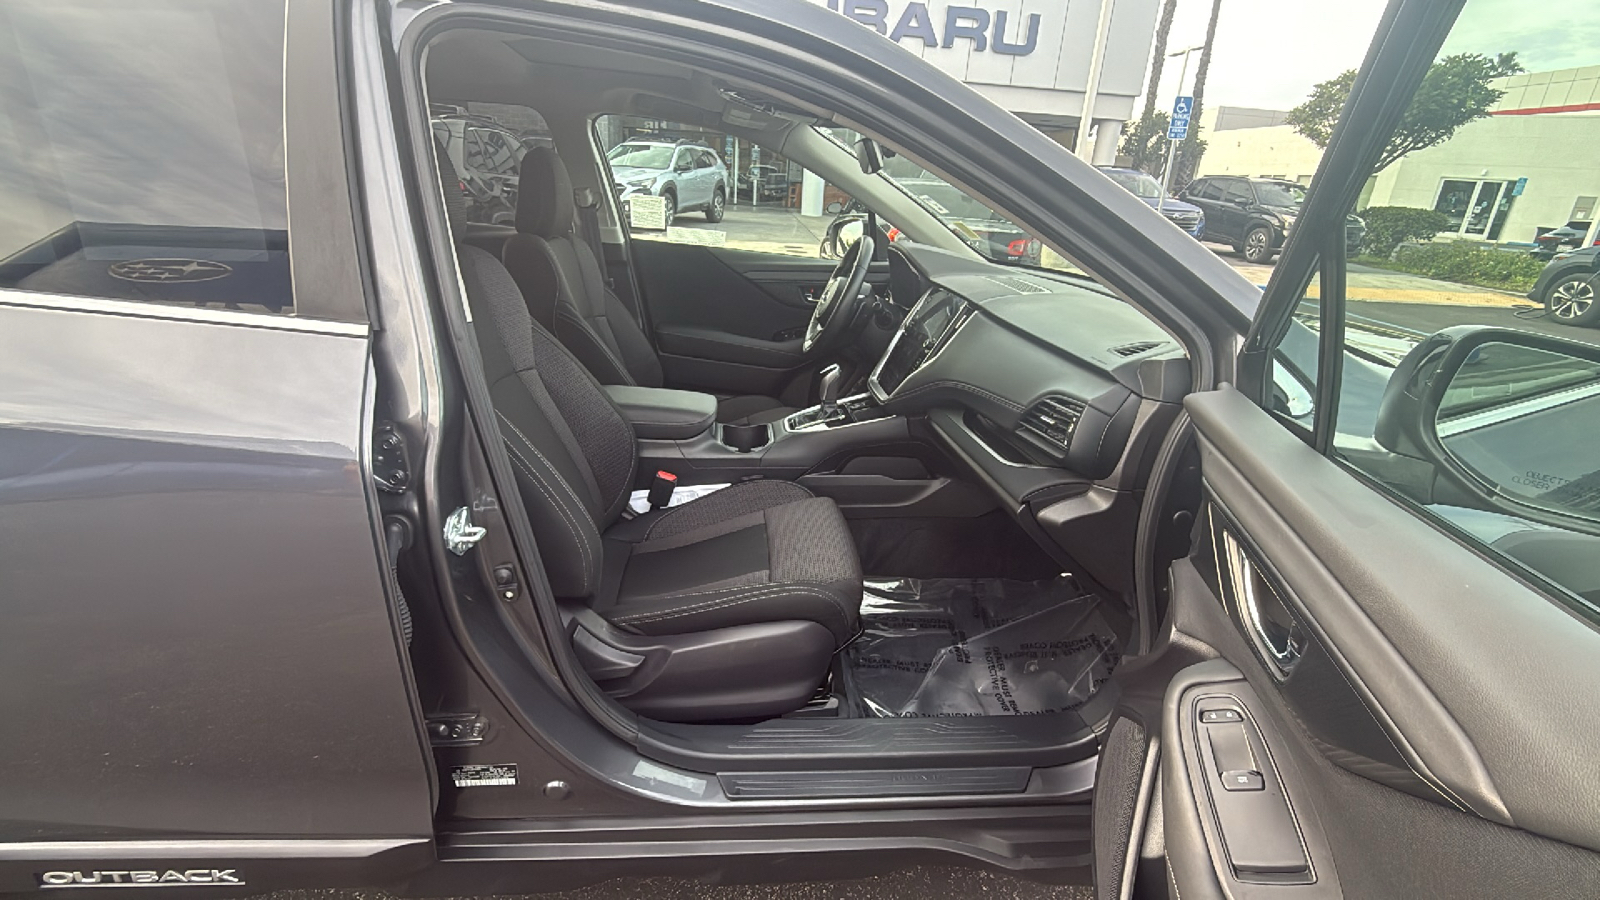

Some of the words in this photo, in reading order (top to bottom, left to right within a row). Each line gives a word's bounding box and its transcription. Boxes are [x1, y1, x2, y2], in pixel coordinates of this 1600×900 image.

[827, 0, 1041, 56] BARU
[1511, 475, 1551, 490] CLOSER
[994, 692, 1010, 713] COVER
[42, 869, 240, 884] OUTBACK
